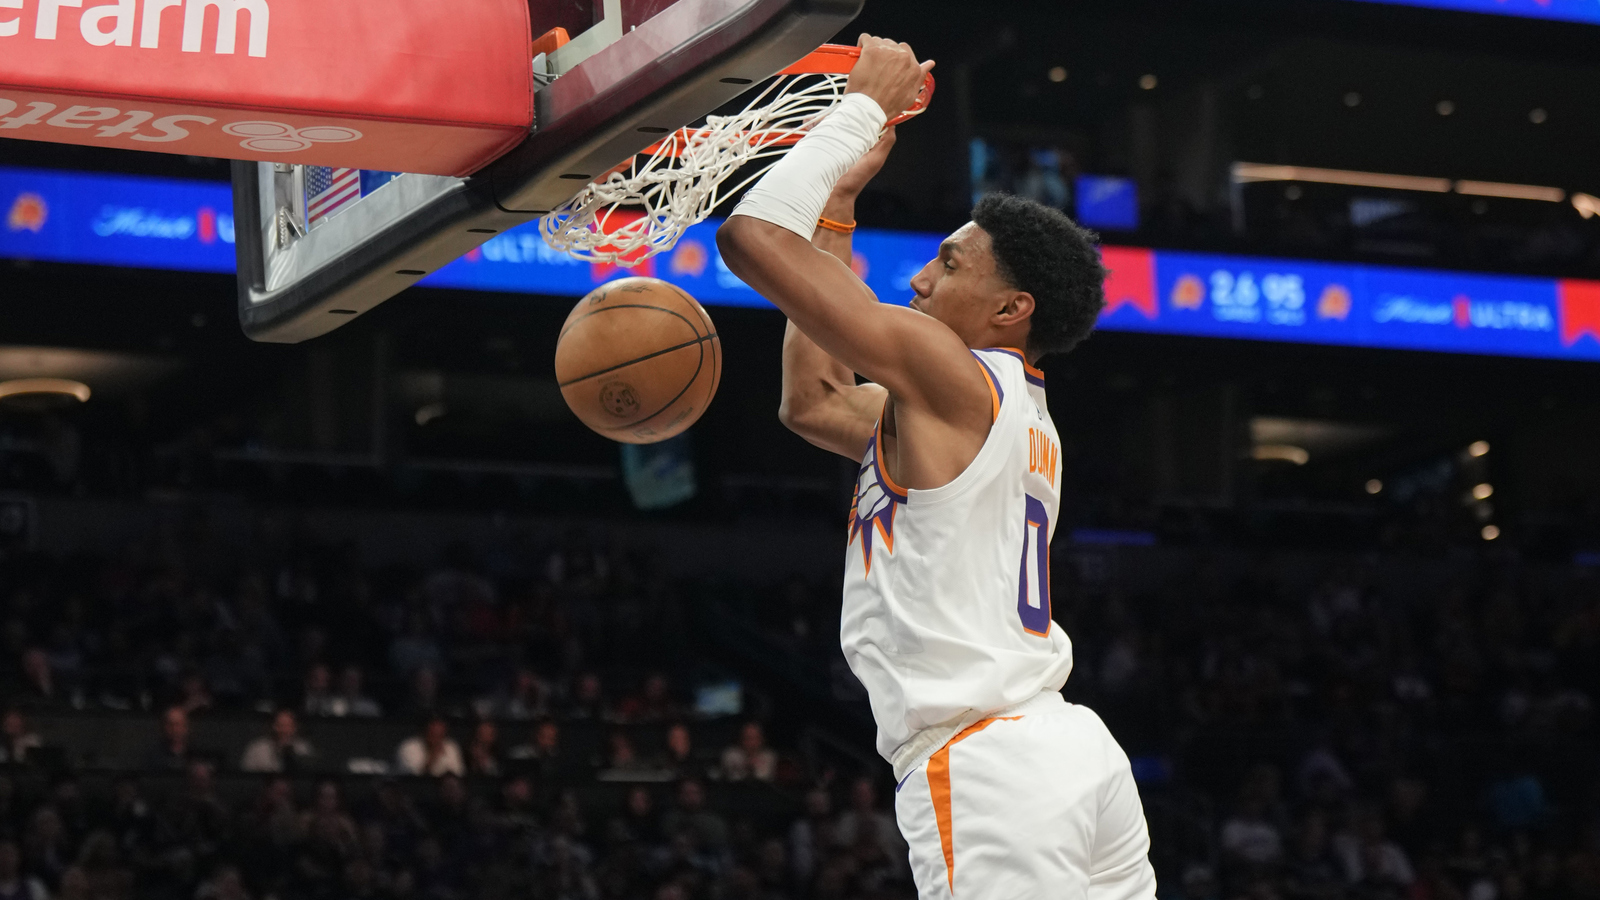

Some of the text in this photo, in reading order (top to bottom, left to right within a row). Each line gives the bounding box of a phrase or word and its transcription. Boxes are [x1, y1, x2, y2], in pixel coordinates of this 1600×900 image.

[481, 233, 580, 266] ULT
[1029, 427, 1058, 490] DUNN
[1018, 492, 1052, 638] 0
